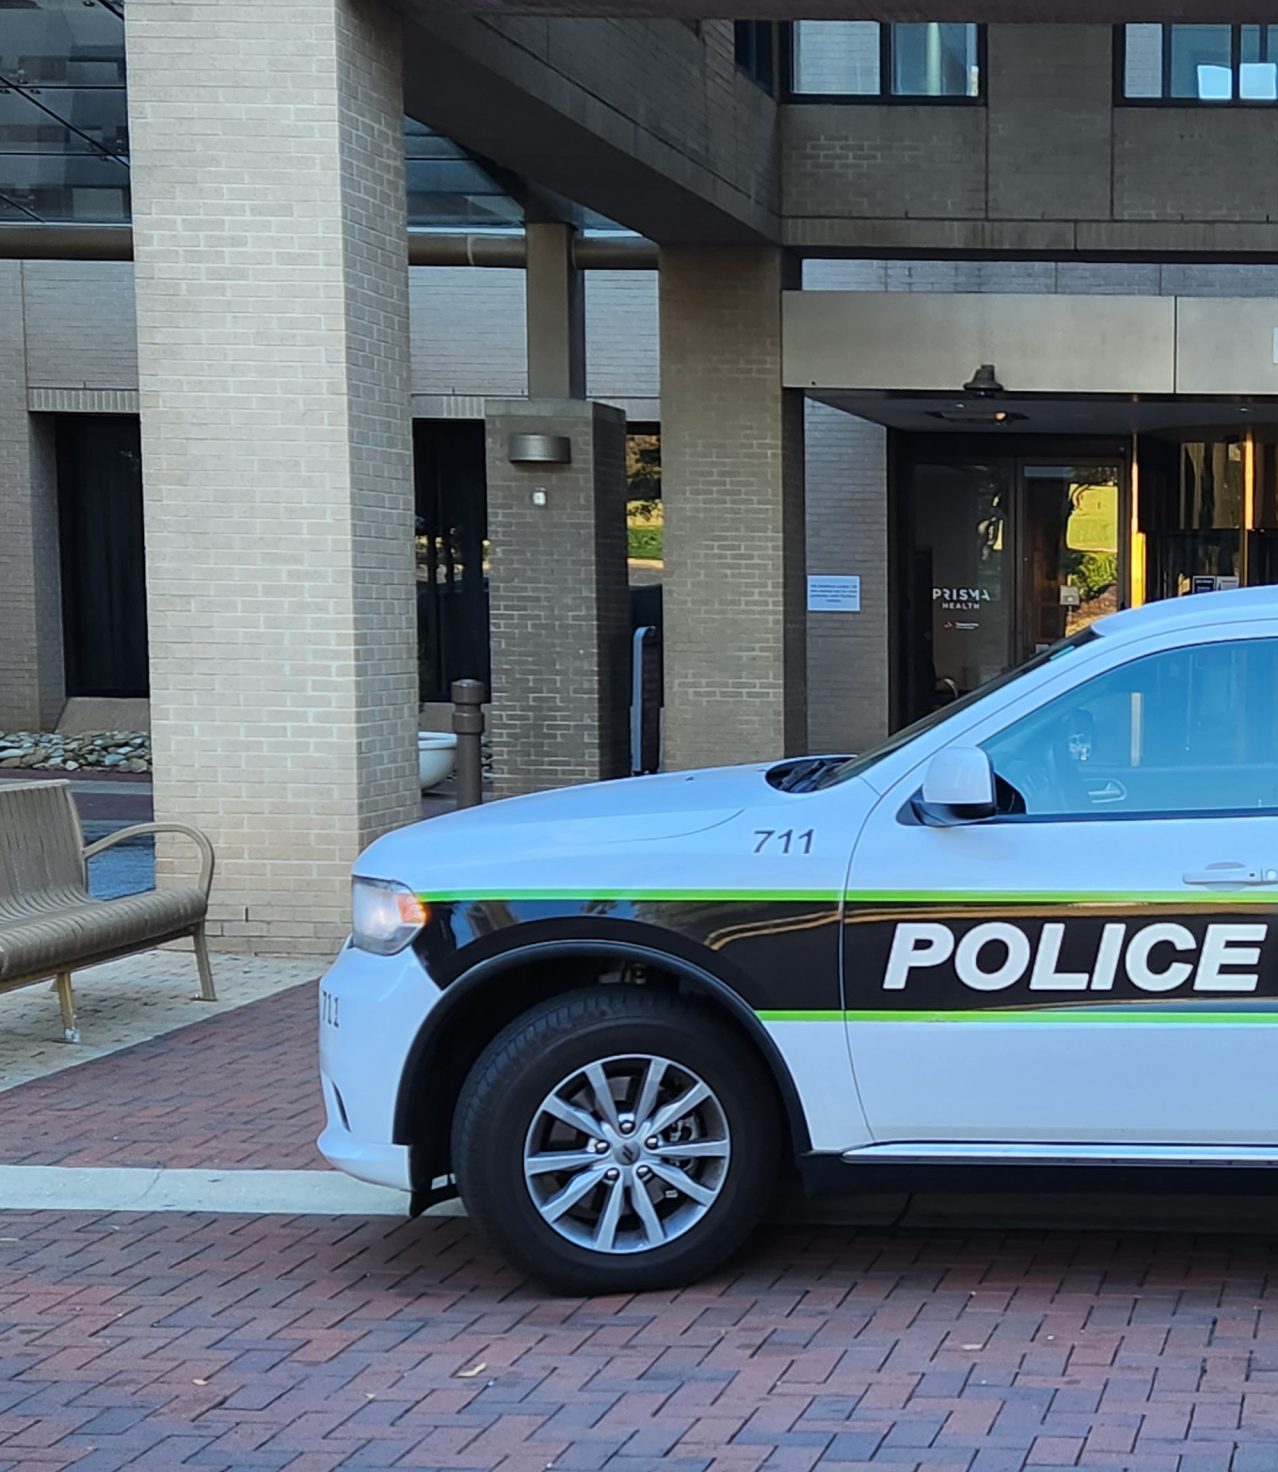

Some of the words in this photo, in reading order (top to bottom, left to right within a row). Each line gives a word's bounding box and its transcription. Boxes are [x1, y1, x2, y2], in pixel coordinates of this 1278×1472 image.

[932, 588, 991, 601] PRISMA
[754, 828, 814, 854] 711
[882, 921, 1268, 992] POLICE
